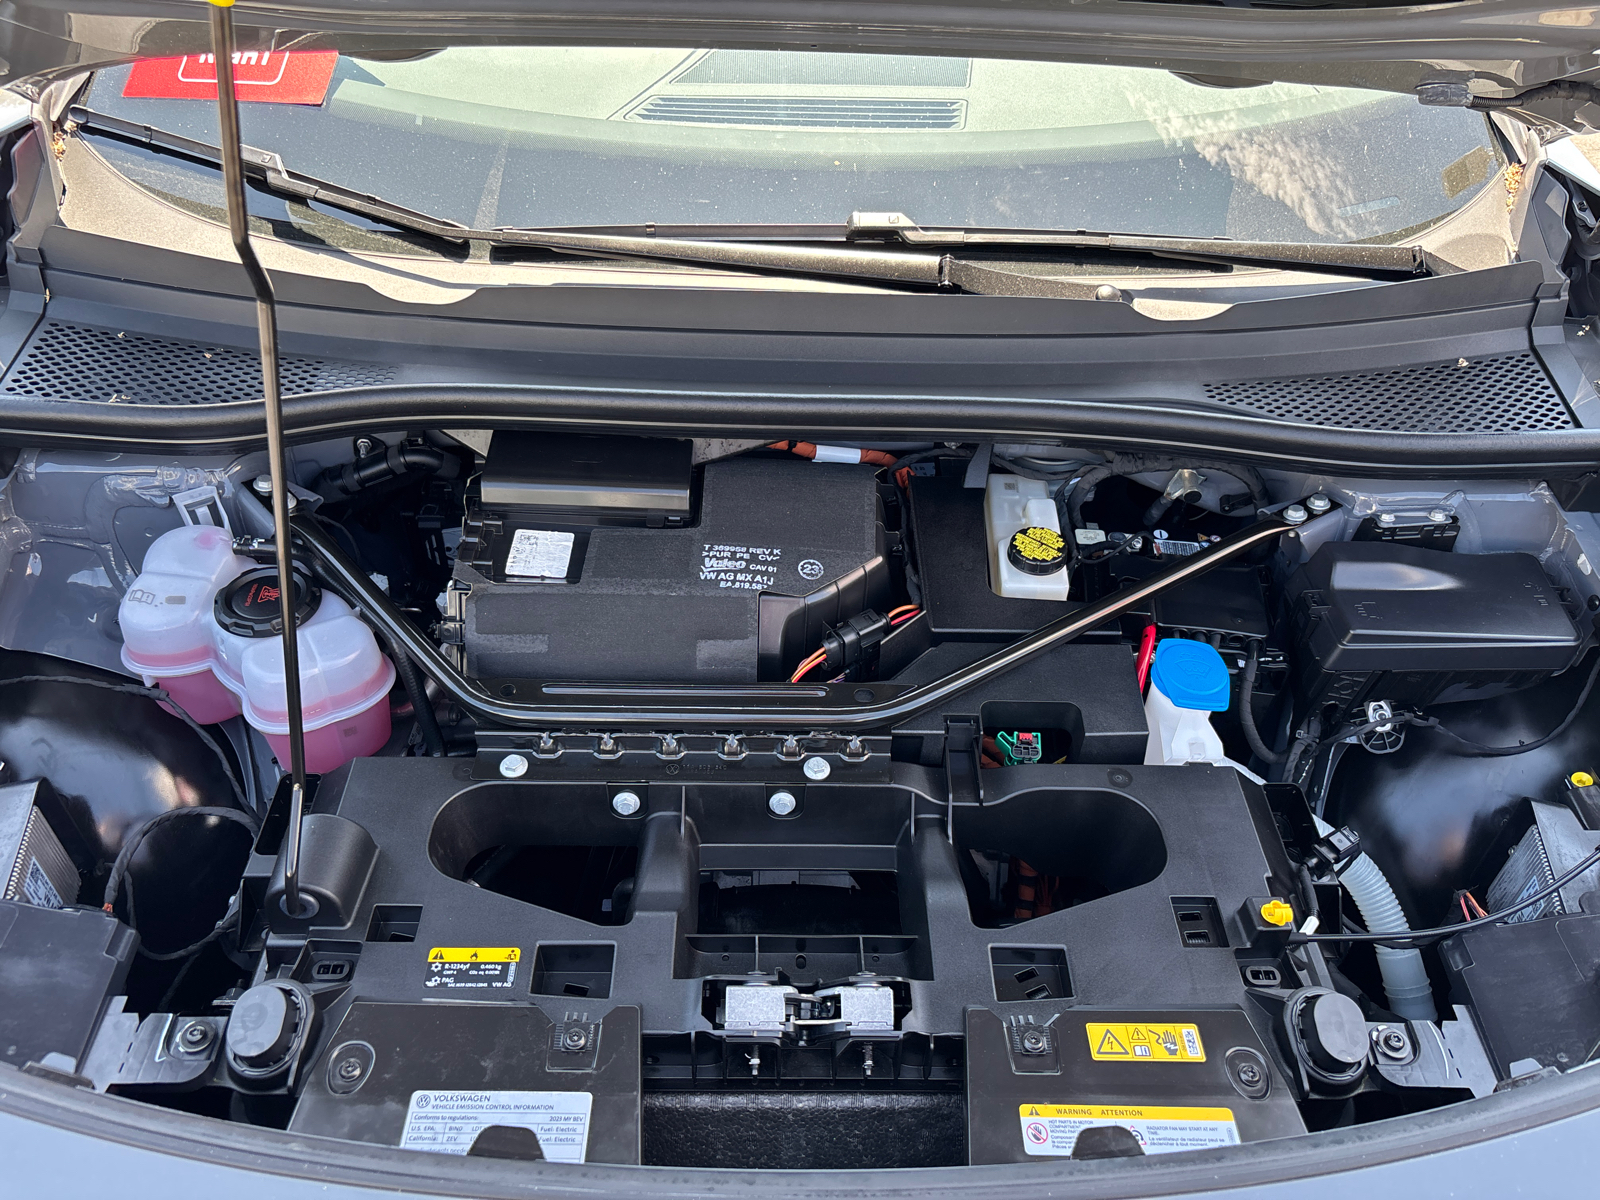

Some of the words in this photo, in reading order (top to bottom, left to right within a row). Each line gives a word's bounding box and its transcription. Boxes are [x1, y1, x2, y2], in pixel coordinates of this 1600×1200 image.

[748, 547, 771, 555] REV
[704, 557, 747, 569] Valeo
[750, 564, 766, 572] CAV
[802, 564, 820, 574] 23
[699, 572, 717, 580] VW
[718, 572, 735, 580] AG
[736, 572, 754, 582] MX
[754, 574, 774, 586] A1J
[444, 963, 471, 971] R-1234yf
[434, 1094, 491, 1102] VOLKSWAGEN
